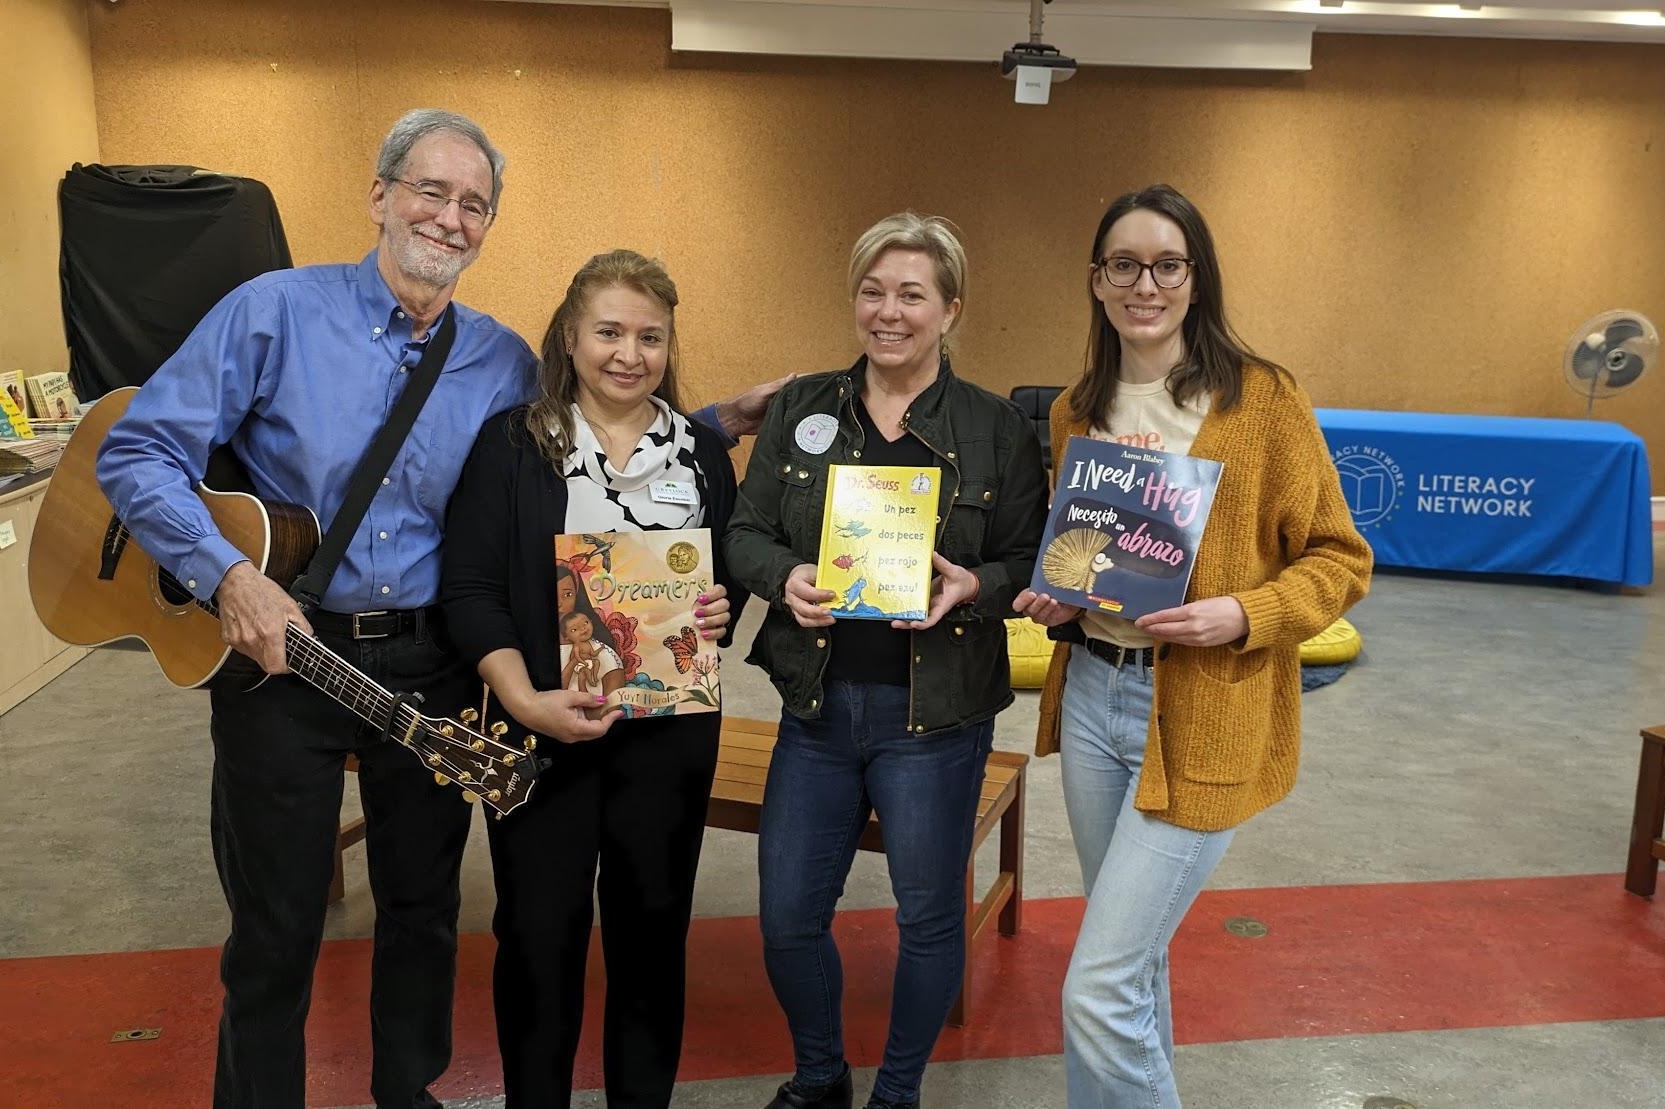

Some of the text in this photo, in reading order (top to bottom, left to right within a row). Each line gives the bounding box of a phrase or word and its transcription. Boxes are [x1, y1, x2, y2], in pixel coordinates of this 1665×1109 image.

[1121, 450, 1164, 466] Aaron Blabey
[1363, 446, 1405, 488] NETWORK
[866, 473, 899, 491] Seuss
[1419, 474, 1535, 496] LITERACY
[1067, 459, 1201, 528] I Need a Hug
[884, 504, 916, 517] Un pez
[1417, 496, 1532, 517] NETWORK
[878, 529, 924, 542] dos peces
[1067, 504, 1184, 566] Necesito un abrazo
[878, 556, 917, 568] pez rojo
[589, 571, 707, 604] Dreamers
[878, 582, 895, 594] pez
[643, 692, 680, 706] Morales
